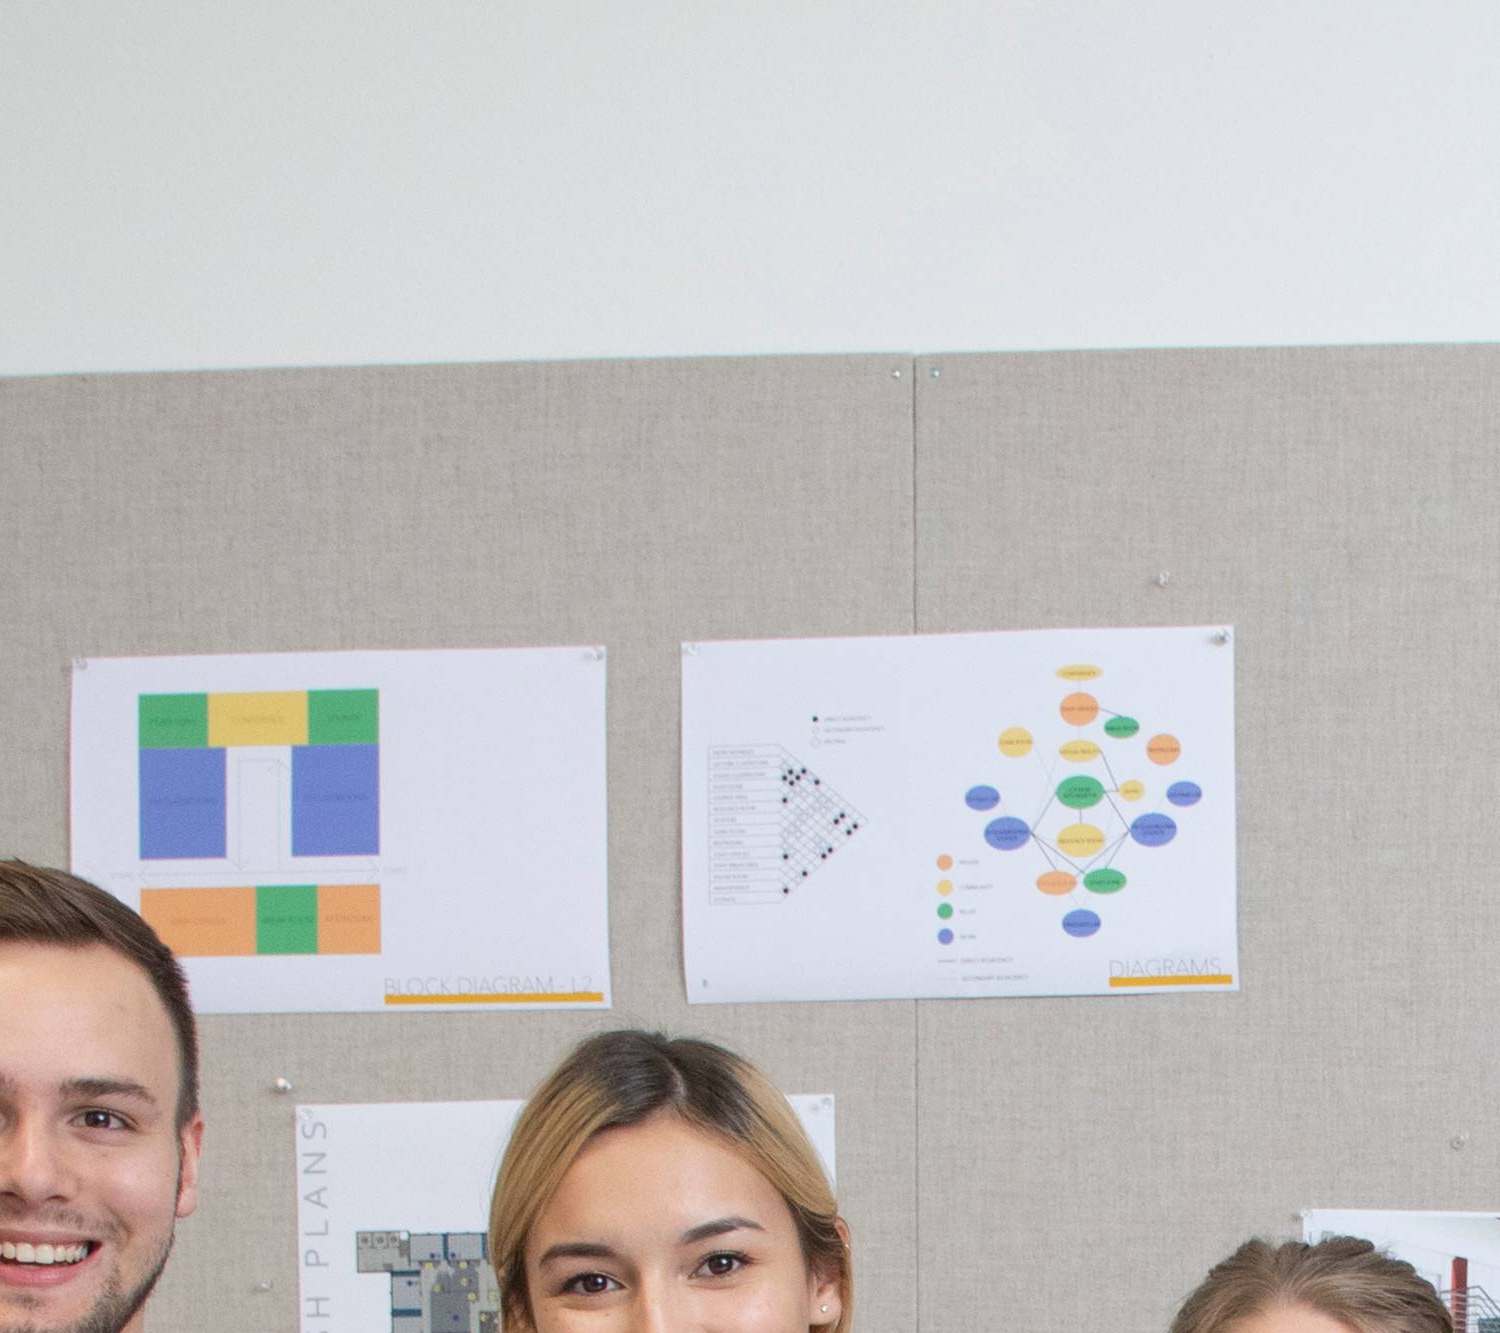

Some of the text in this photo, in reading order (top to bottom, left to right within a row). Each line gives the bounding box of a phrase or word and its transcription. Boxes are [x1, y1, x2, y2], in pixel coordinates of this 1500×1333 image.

[1109, 956, 1221, 976] DIAGRAMS
[384, 977, 452, 996] BLOCK
[456, 976, 553, 995] DIAGRAM
[301, 1120, 330, 1268] PLANS
